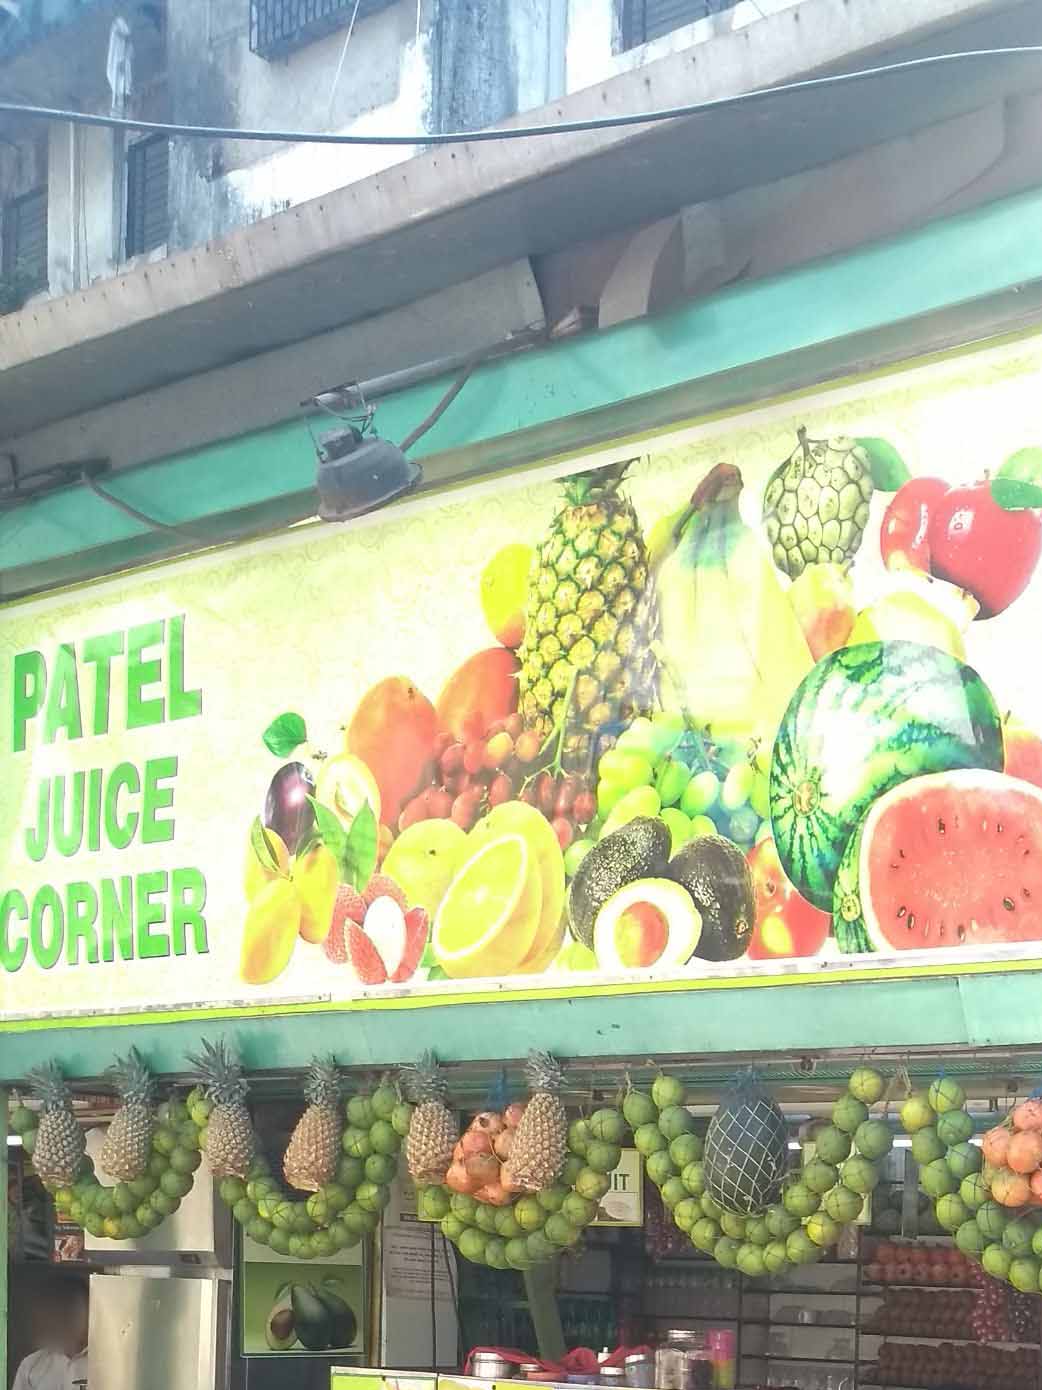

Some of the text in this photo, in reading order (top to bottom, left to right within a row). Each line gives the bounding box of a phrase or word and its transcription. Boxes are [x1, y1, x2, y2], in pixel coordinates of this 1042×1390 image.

[13, 613, 203, 752] PATEL
[25, 756, 178, 862] JUICE
[0, 867, 209, 972] CORNER
